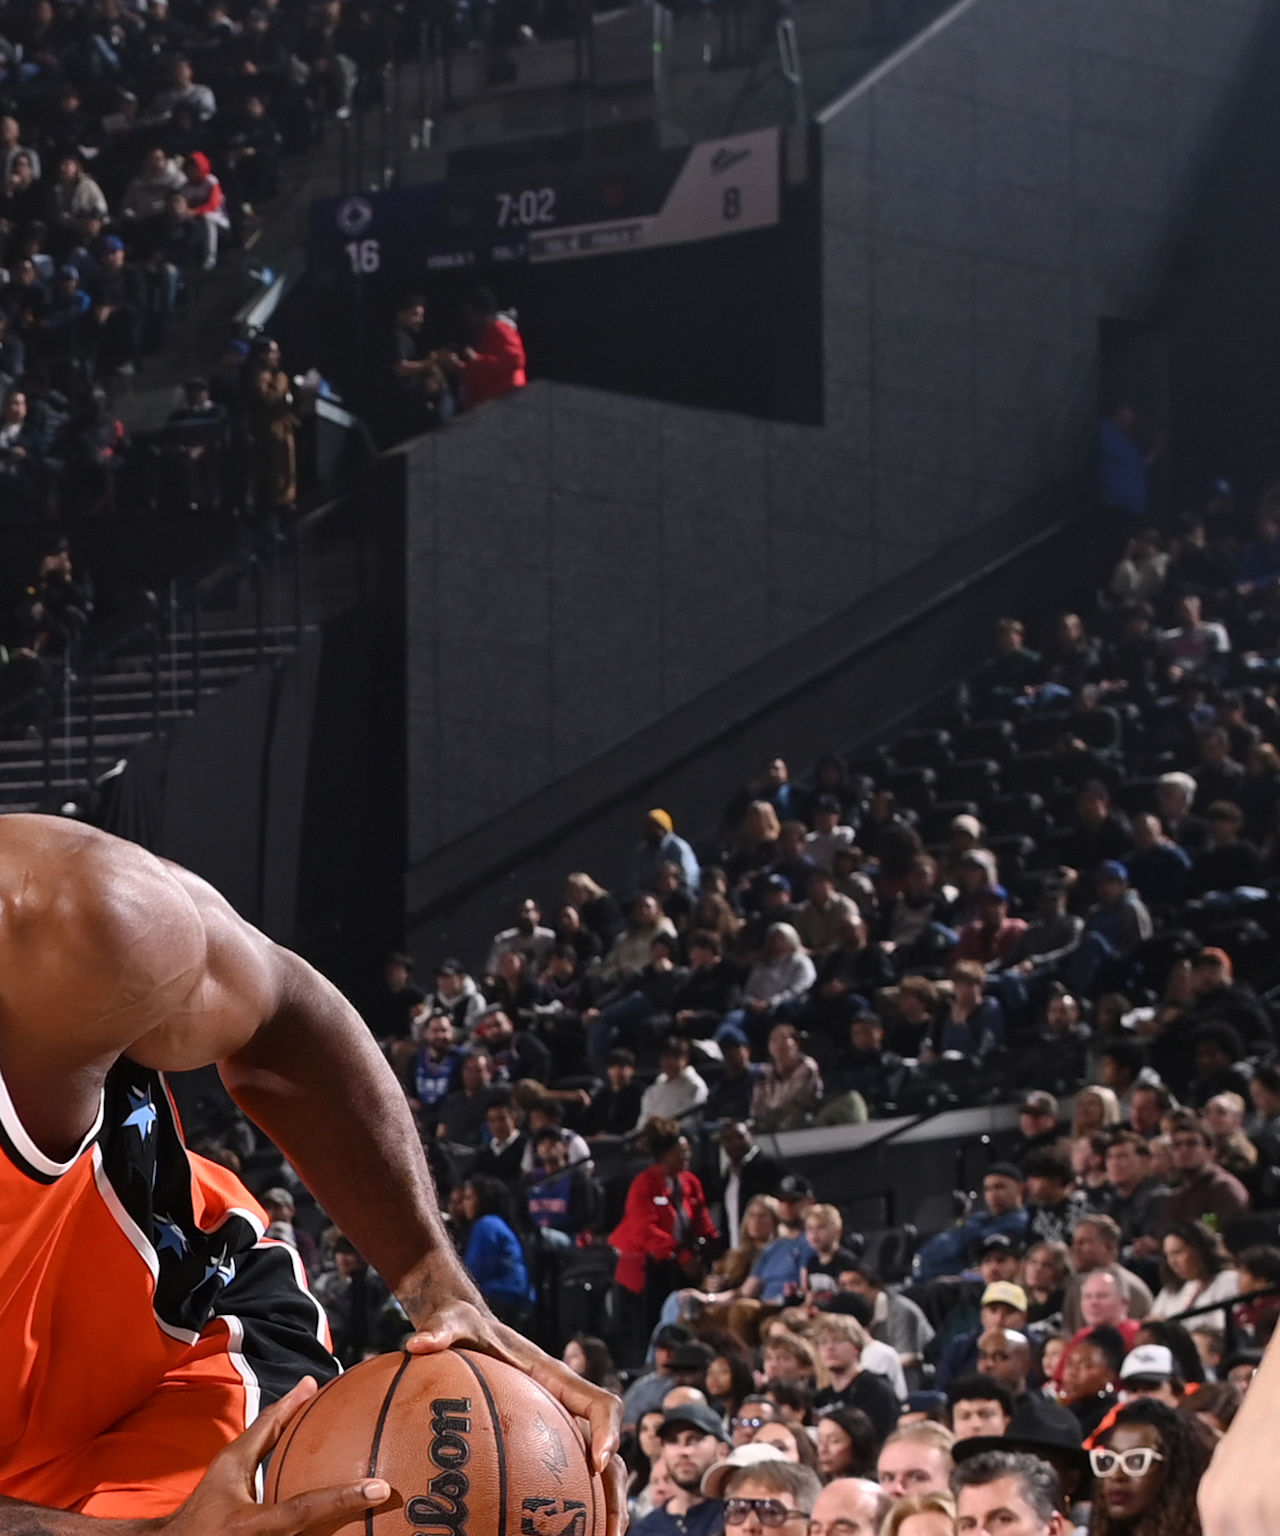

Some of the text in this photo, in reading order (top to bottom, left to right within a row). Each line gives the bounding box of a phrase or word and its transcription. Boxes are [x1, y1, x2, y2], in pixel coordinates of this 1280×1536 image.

[495, 188, 556, 227] 7:02
[723, 186, 741, 220] 8
[345, 240, 381, 273] 16
